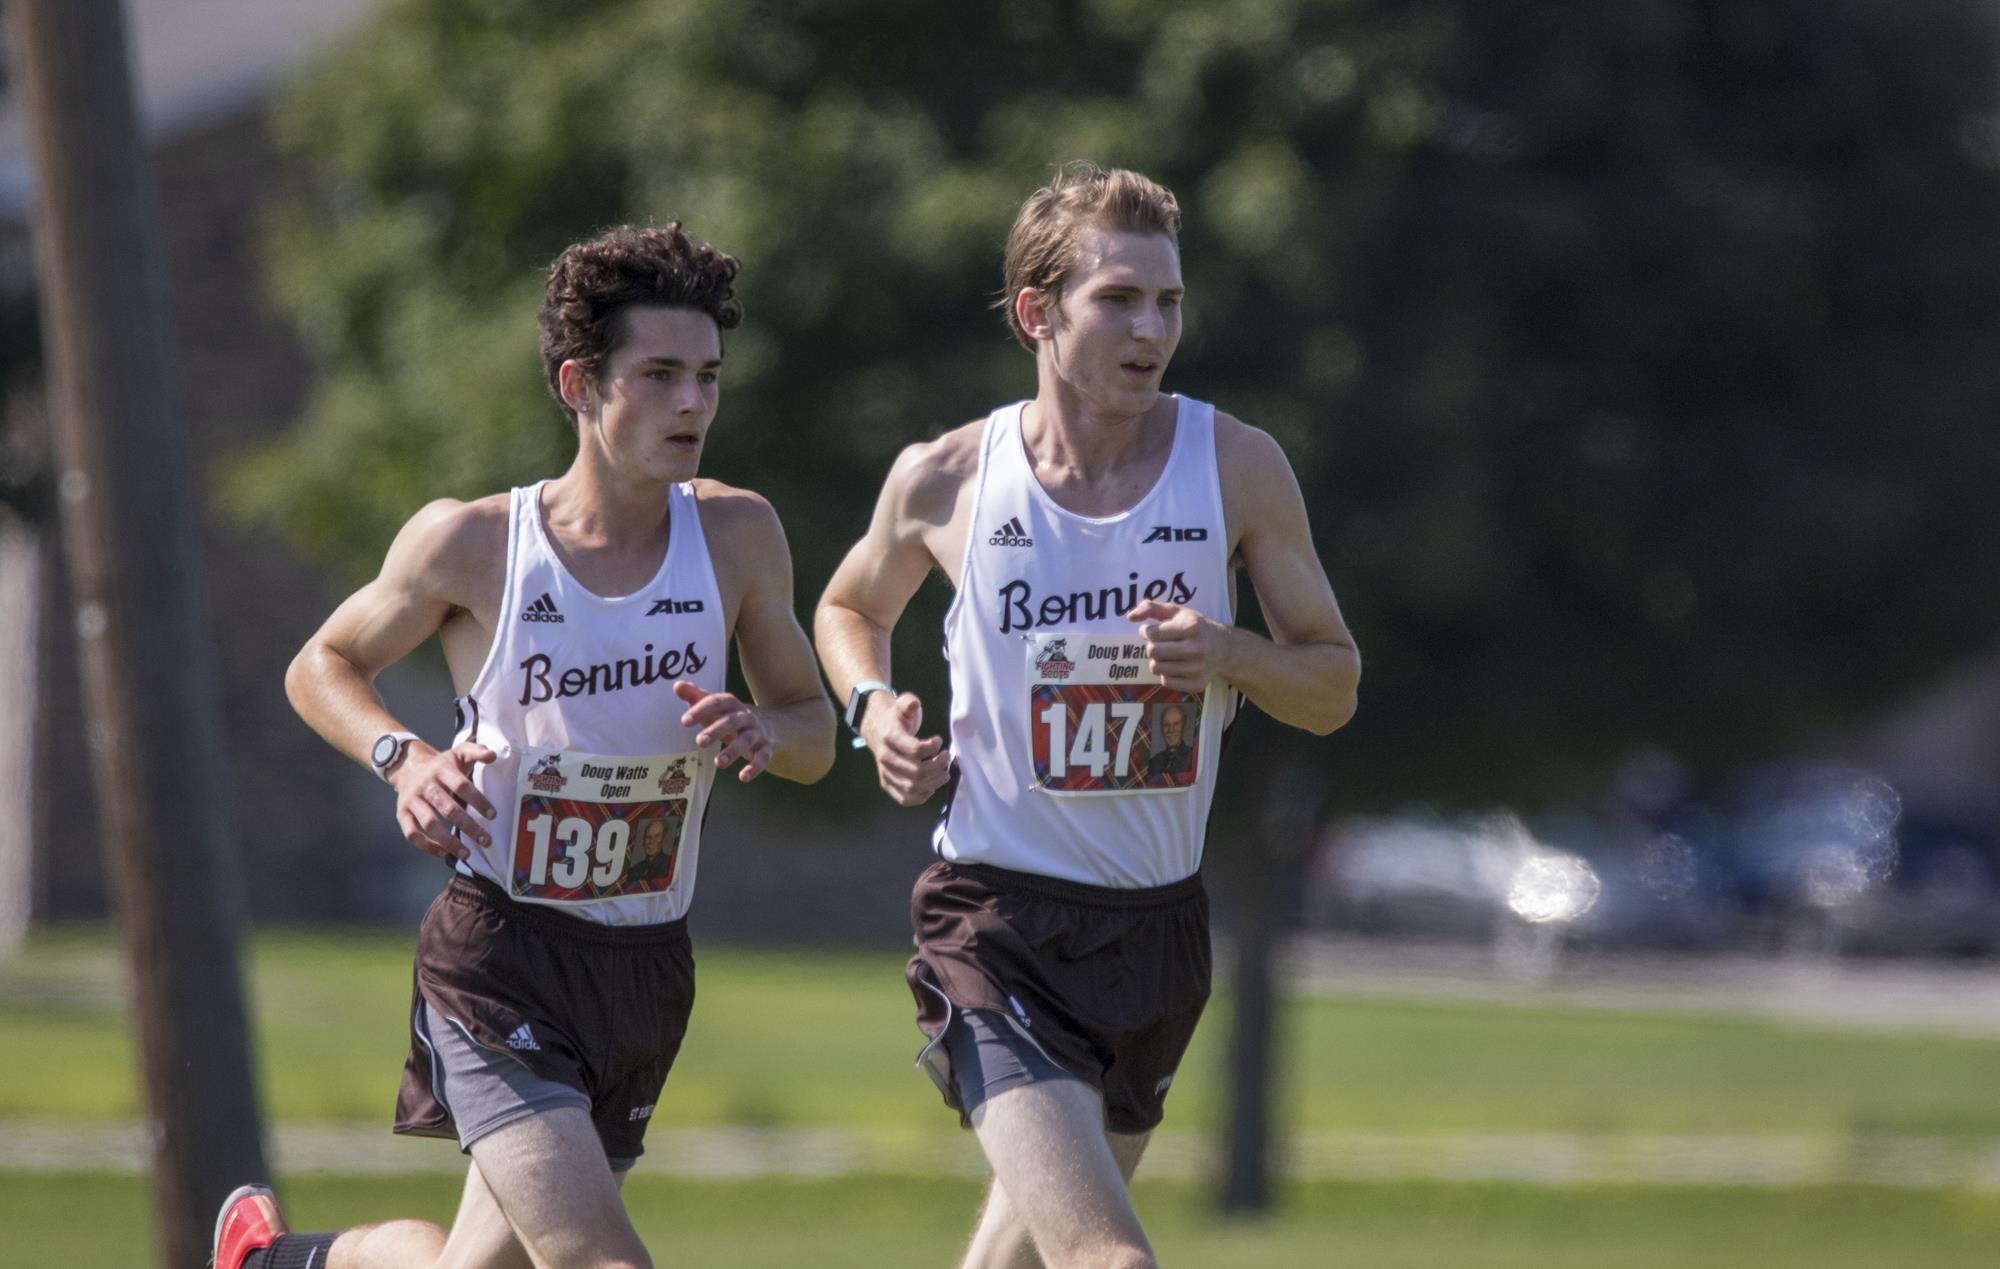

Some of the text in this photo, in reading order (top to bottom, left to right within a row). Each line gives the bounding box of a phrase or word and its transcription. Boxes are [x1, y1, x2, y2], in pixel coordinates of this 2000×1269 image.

[989, 535, 1033, 547] adidas
[999, 571, 1197, 634] Bonnies
[521, 612, 564, 623] adidas
[1087, 644, 1148, 661] Doug Wat
[518, 641, 707, 706] Bonnies
[1035, 661, 1075, 671] FIGHTING
[1108, 663, 1139, 680] Open
[1040, 703, 1145, 778] 147
[580, 764, 649, 780] Doug Watts
[600, 784, 631, 799] Open
[525, 813, 631, 889] 139
